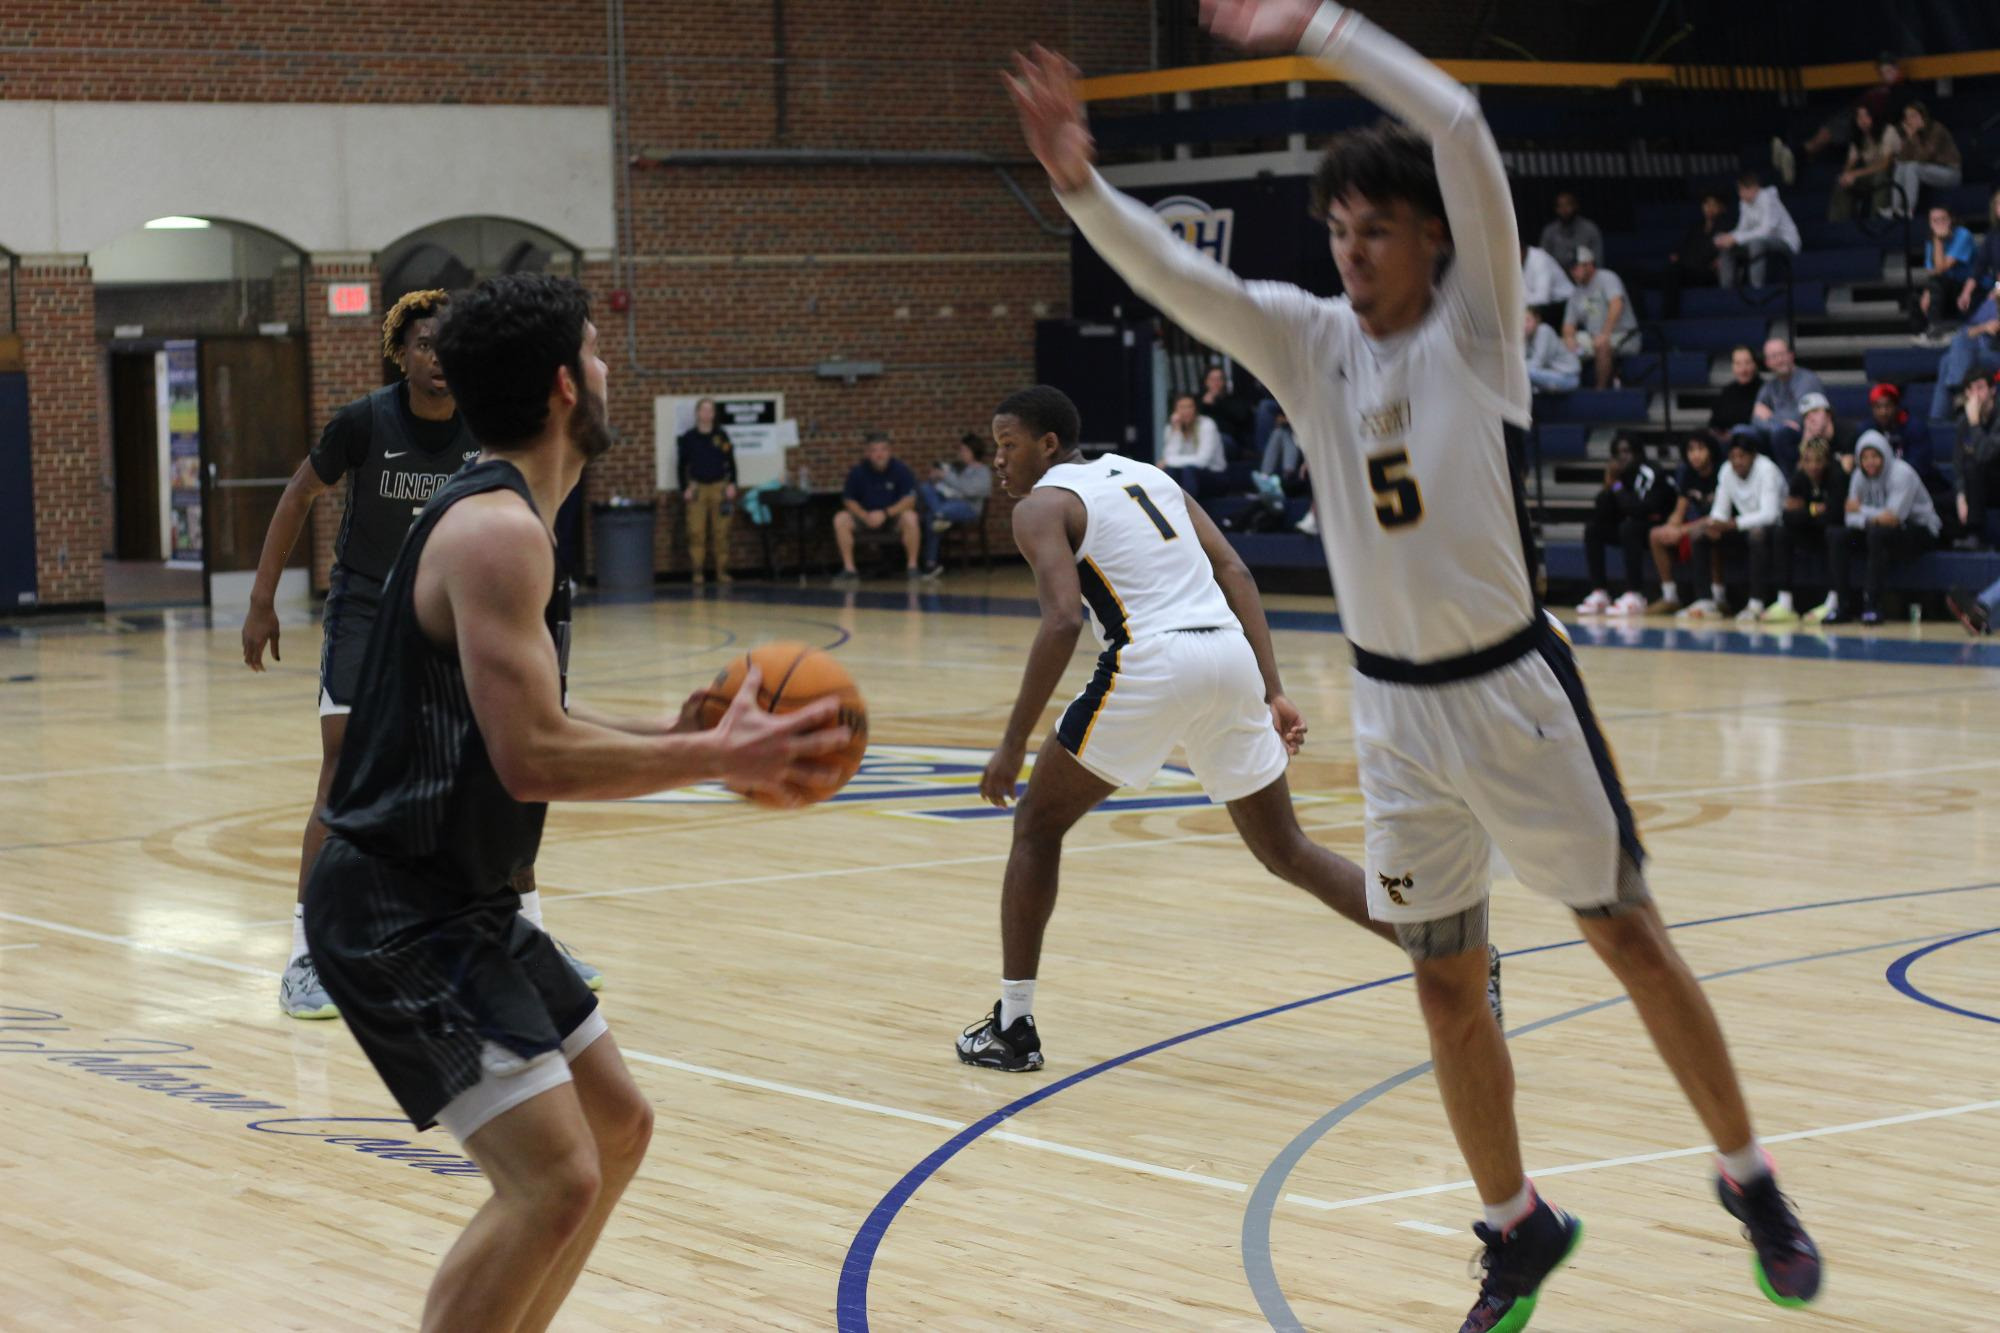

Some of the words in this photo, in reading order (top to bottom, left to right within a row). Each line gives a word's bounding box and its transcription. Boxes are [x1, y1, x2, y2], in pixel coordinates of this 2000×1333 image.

[380, 470, 454, 500] LINCO
[1122, 483, 1178, 543] 1
[1366, 447, 1424, 529] 5
